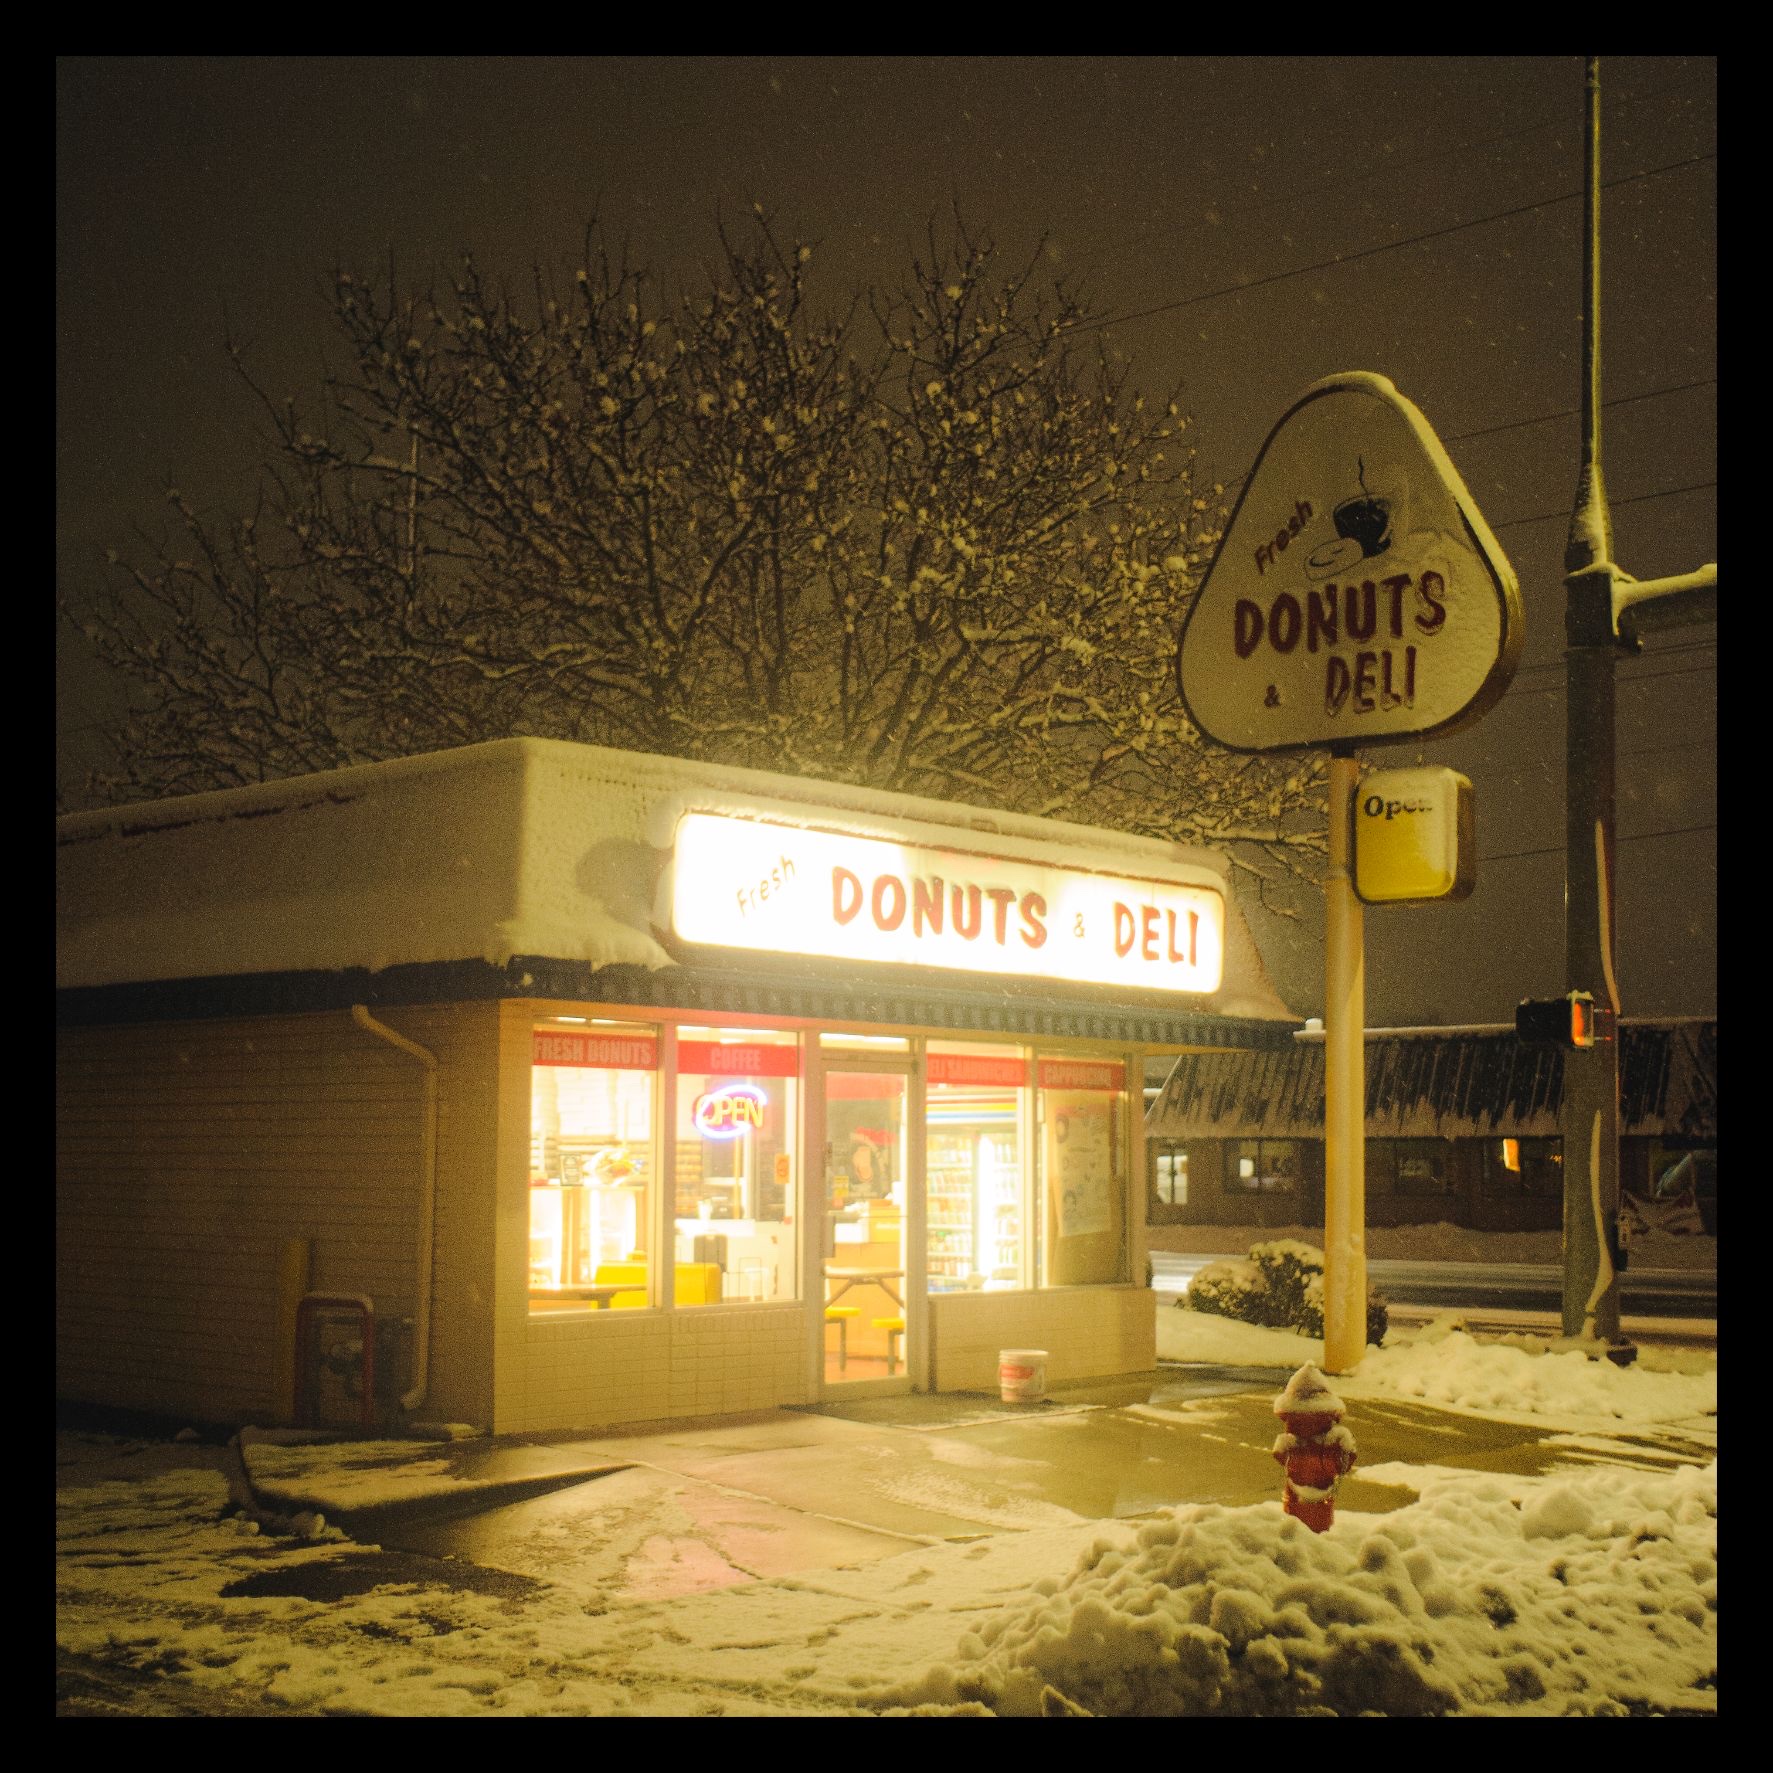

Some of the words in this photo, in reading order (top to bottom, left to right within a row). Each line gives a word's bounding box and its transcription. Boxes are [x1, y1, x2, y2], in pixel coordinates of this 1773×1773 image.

[1254, 500, 1313, 575] Fresh
[1234, 570, 1446, 660] DONUTS
[1264, 684, 1281, 708] &
[1324, 645, 1417, 718] DELI
[736, 855, 797, 920] Fresh
[831, 866, 1048, 950] DONUTS
[1074, 913, 1086, 939] &
[1114, 902, 1200, 967] DELI
[534, 1037, 584, 1062] FRESH
[587, 1039, 653, 1065] DONUTS
[710, 1048, 761, 1071] COFFEE
[693, 1094, 764, 1129] OPEN
